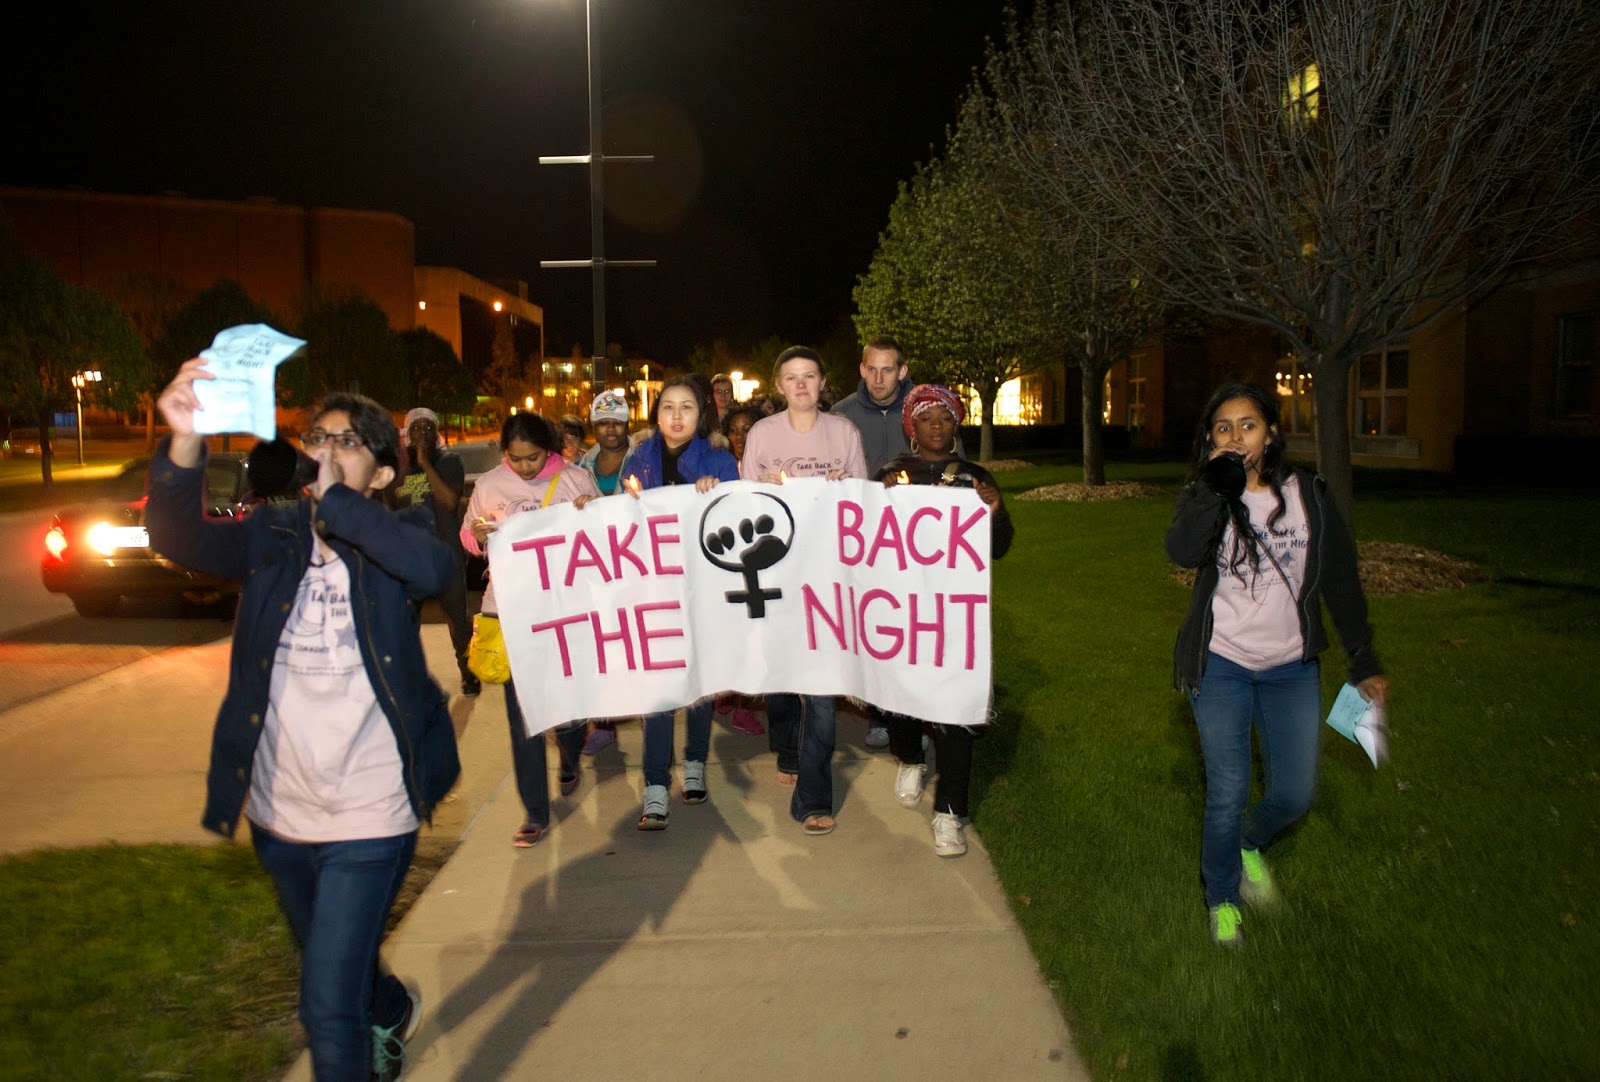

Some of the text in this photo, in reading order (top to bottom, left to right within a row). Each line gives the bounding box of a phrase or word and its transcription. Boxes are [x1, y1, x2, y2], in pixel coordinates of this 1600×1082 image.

[512, 500, 988, 590] TAKE BACK
[1274, 539, 1307, 550] THE NIG
[531, 582, 989, 677] THE NIGHT
